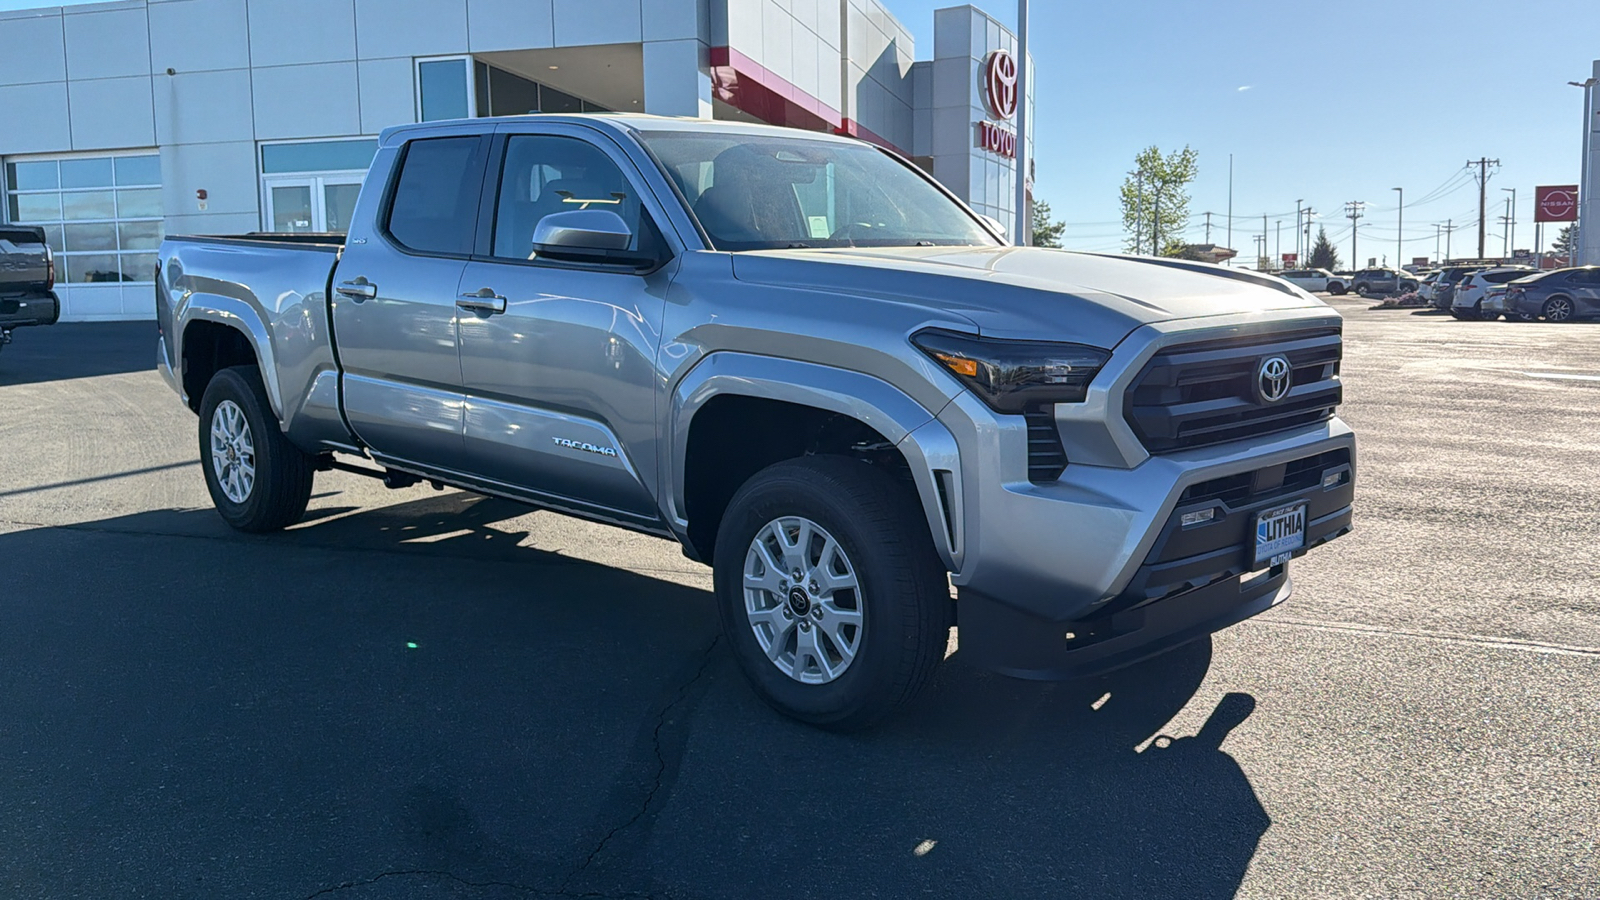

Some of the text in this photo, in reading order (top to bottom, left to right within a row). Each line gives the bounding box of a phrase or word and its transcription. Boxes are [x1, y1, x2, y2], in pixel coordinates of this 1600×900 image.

[980, 121, 1017, 159] TOYOT
[552, 437, 617, 457] TACOMA
[1266, 513, 1303, 542] LITHIA
[1273, 540, 1280, 549] OF
